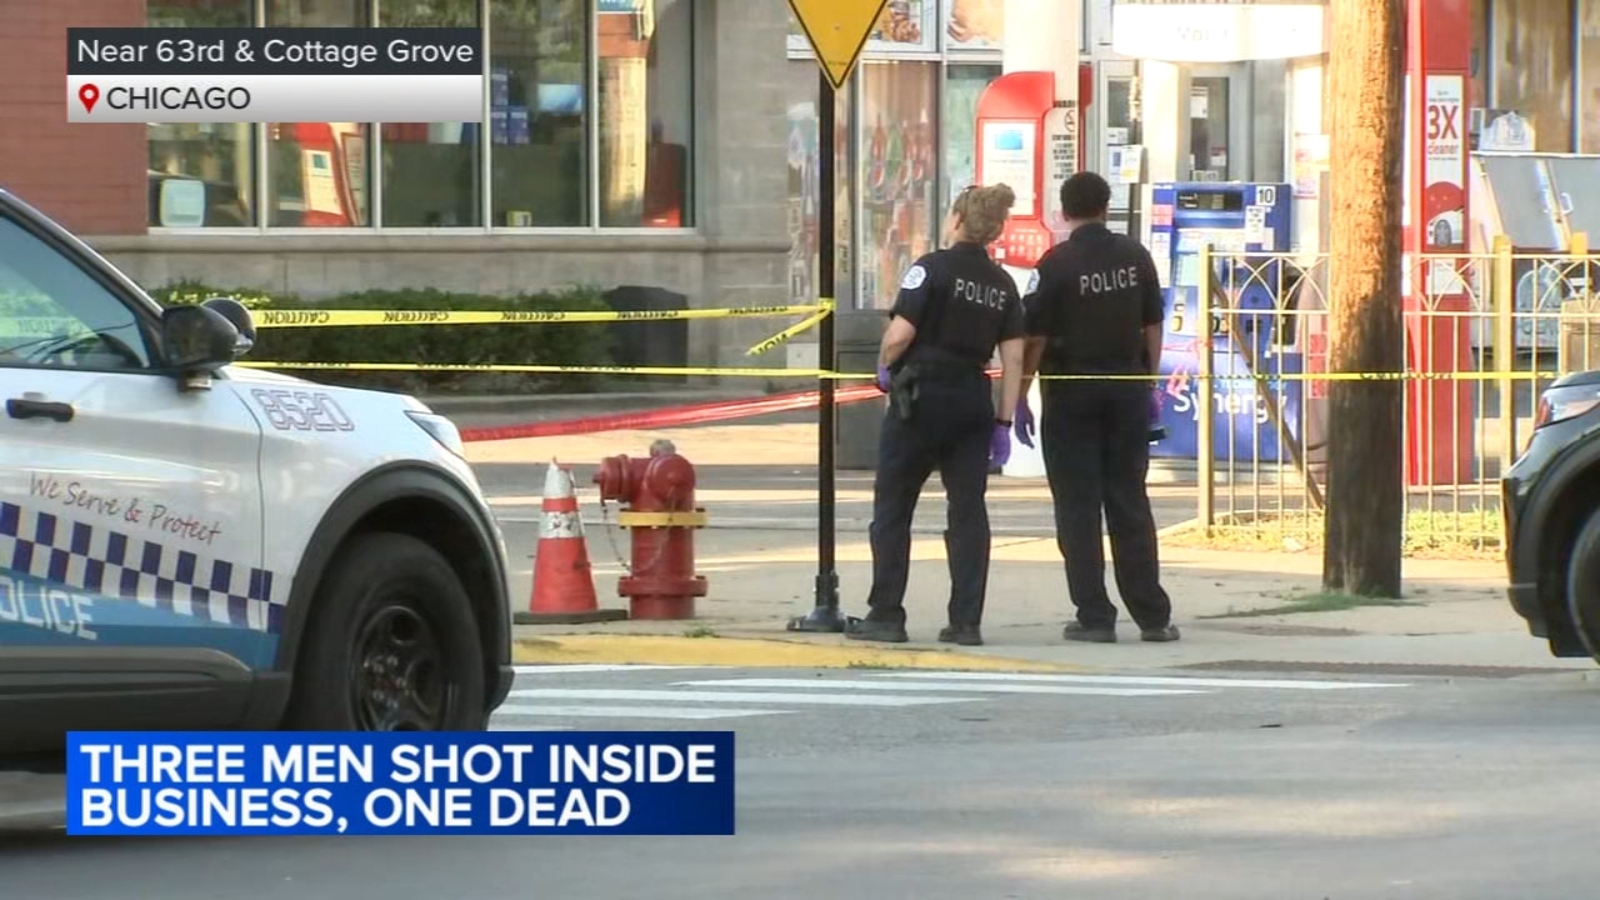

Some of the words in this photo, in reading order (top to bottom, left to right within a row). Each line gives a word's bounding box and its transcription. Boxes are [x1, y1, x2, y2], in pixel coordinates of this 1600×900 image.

[1428, 105, 1458, 140] 3X
[1259, 188, 1274, 204] 10
[954, 279, 1007, 311] POLICE
[1080, 266, 1138, 295] POLICE
[263, 311, 330, 325] CAUTION
[250, 388, 355, 431] 8520
[30, 471, 60, 499] We
[63, 482, 120, 516] Serve
[124, 498, 145, 523] &
[150, 504, 222, 545] Protect
